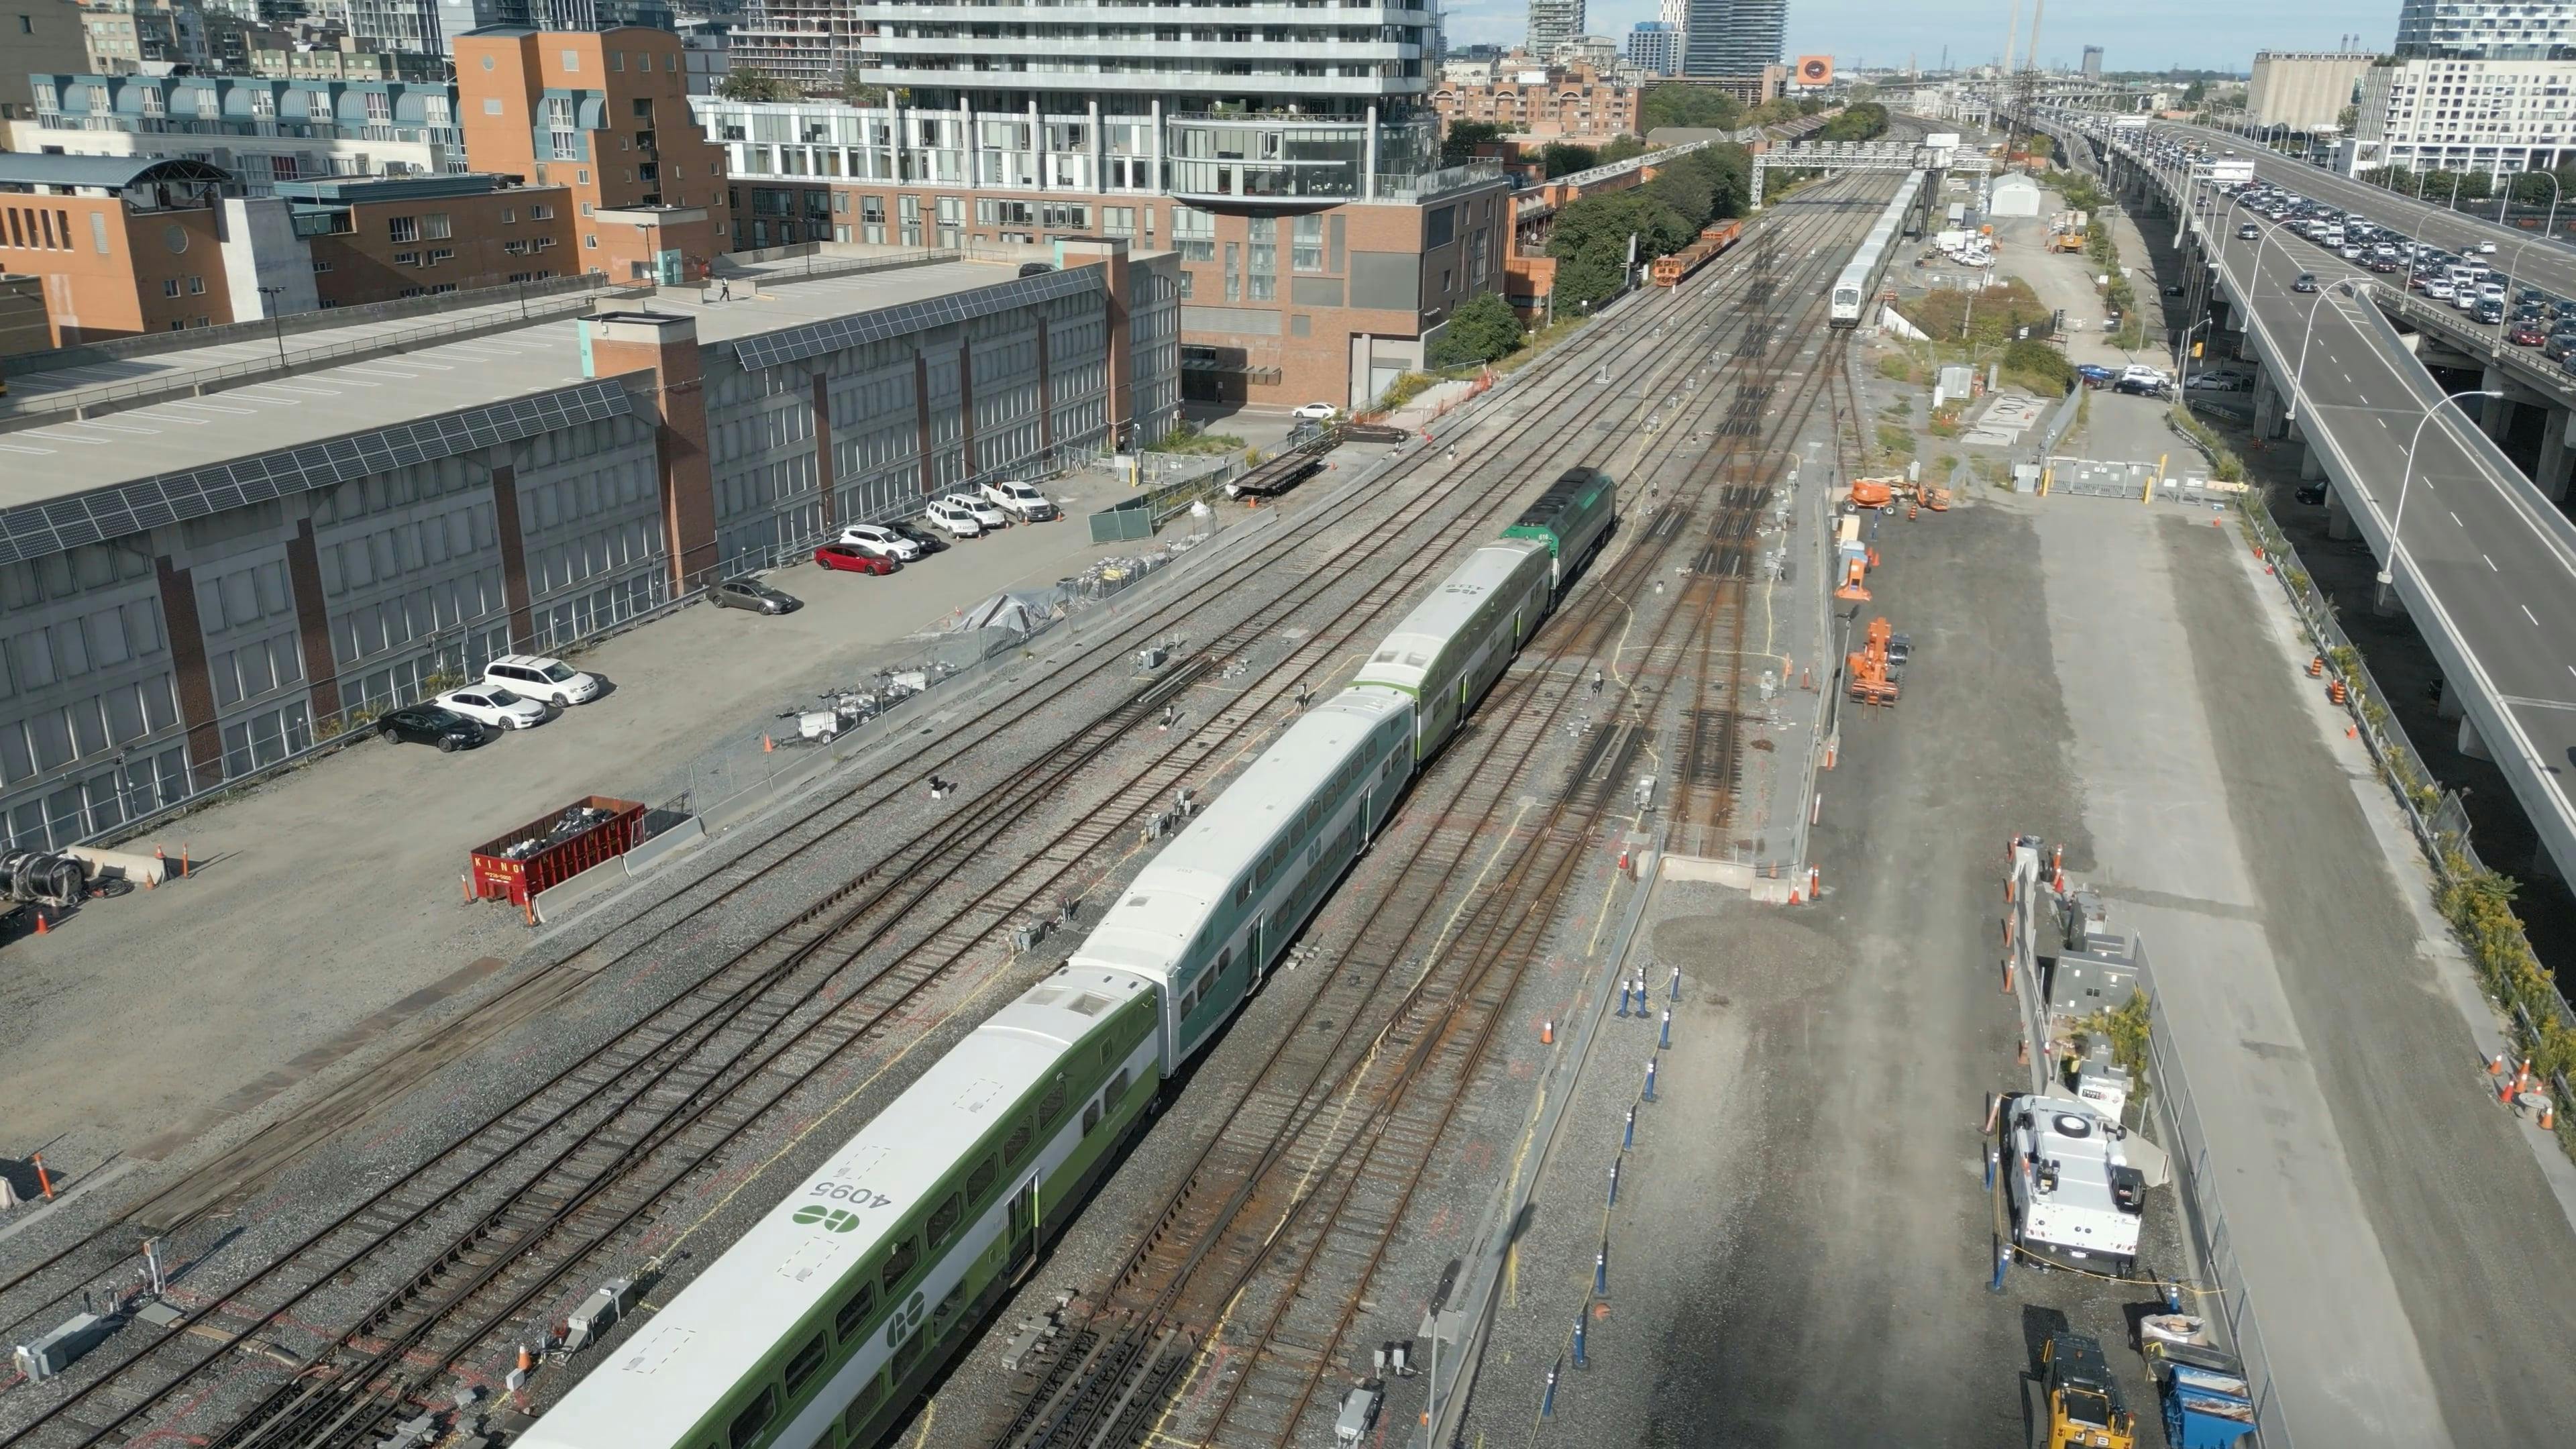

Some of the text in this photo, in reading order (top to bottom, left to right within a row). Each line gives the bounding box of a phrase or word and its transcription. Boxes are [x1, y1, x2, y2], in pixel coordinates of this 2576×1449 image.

[475, 857, 519, 873] KING
[809, 1182, 892, 1210] 4095
[2075, 1432, 2110, 1446] JB
